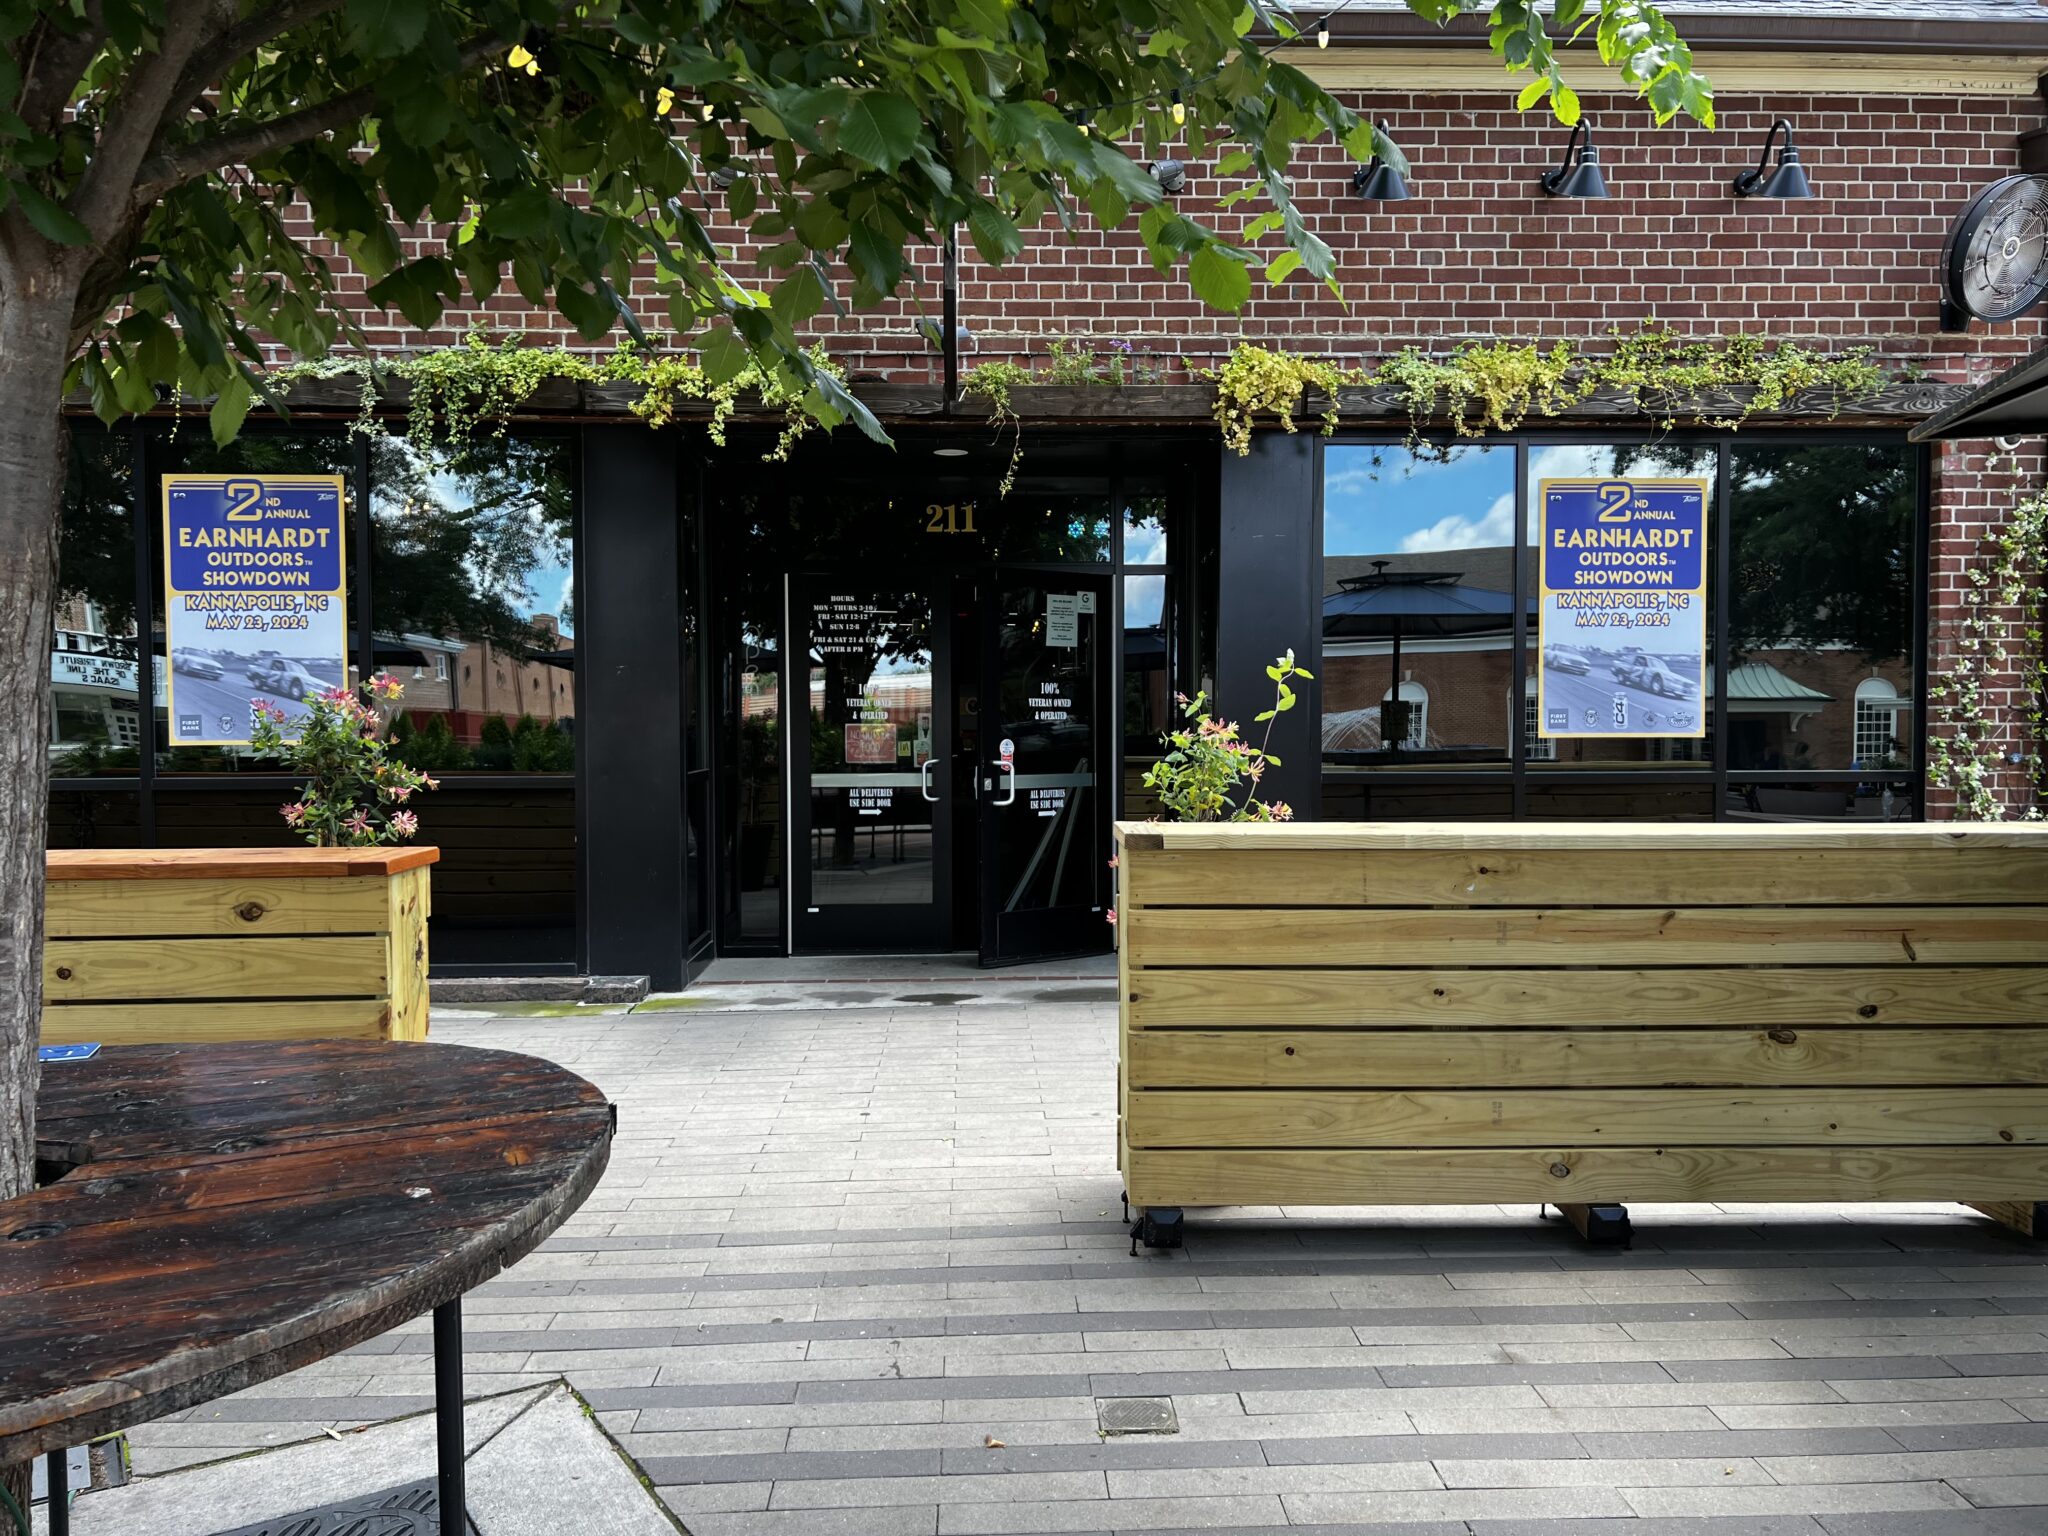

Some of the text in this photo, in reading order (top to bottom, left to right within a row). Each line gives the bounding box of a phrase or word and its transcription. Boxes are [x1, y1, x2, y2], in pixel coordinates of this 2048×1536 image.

[226, 482, 281, 522] 2 ND
[1598, 485, 1649, 523] 2 ND
[264, 509, 311, 519] ANNUAL
[926, 504, 977, 532] 211
[1633, 511, 1676, 520] ANNUAL
[179, 527, 330, 548] EARNHARDT
[1554, 528, 1694, 549] EARNHARDT
[207, 552, 304, 566] OUTDOORS
[1579, 552, 1668, 566] OUTDOORS
[203, 571, 310, 586] SHOWDOWN
[1574, 570, 1673, 585] SHOWDOWN
[185, 592, 328, 613] KANNAPOLIS, NC
[1557, 591, 1689, 611] KANNAPOLIS, NC
[205, 613, 308, 632] MAY 23, 2024
[1575, 611, 1670, 629] MAY 23, 2024
[1041, 682, 1060, 695] 100%
[846, 698, 871, 707] VETERAN
[1028, 698, 1072, 708] VETERAN OWNED
[852, 711, 889, 720] & OPERATED
[1034, 711, 1068, 720] & OPERATED
[1615, 701, 1625, 724] C4
[849, 788, 893, 797] ALL DELIVERIES
[1030, 789, 1066, 799] ALL DELIVERIES
[849, 798, 891, 807] USE SIDE DOOR
[1030, 799, 1064, 809] USE SIDE DOOR
